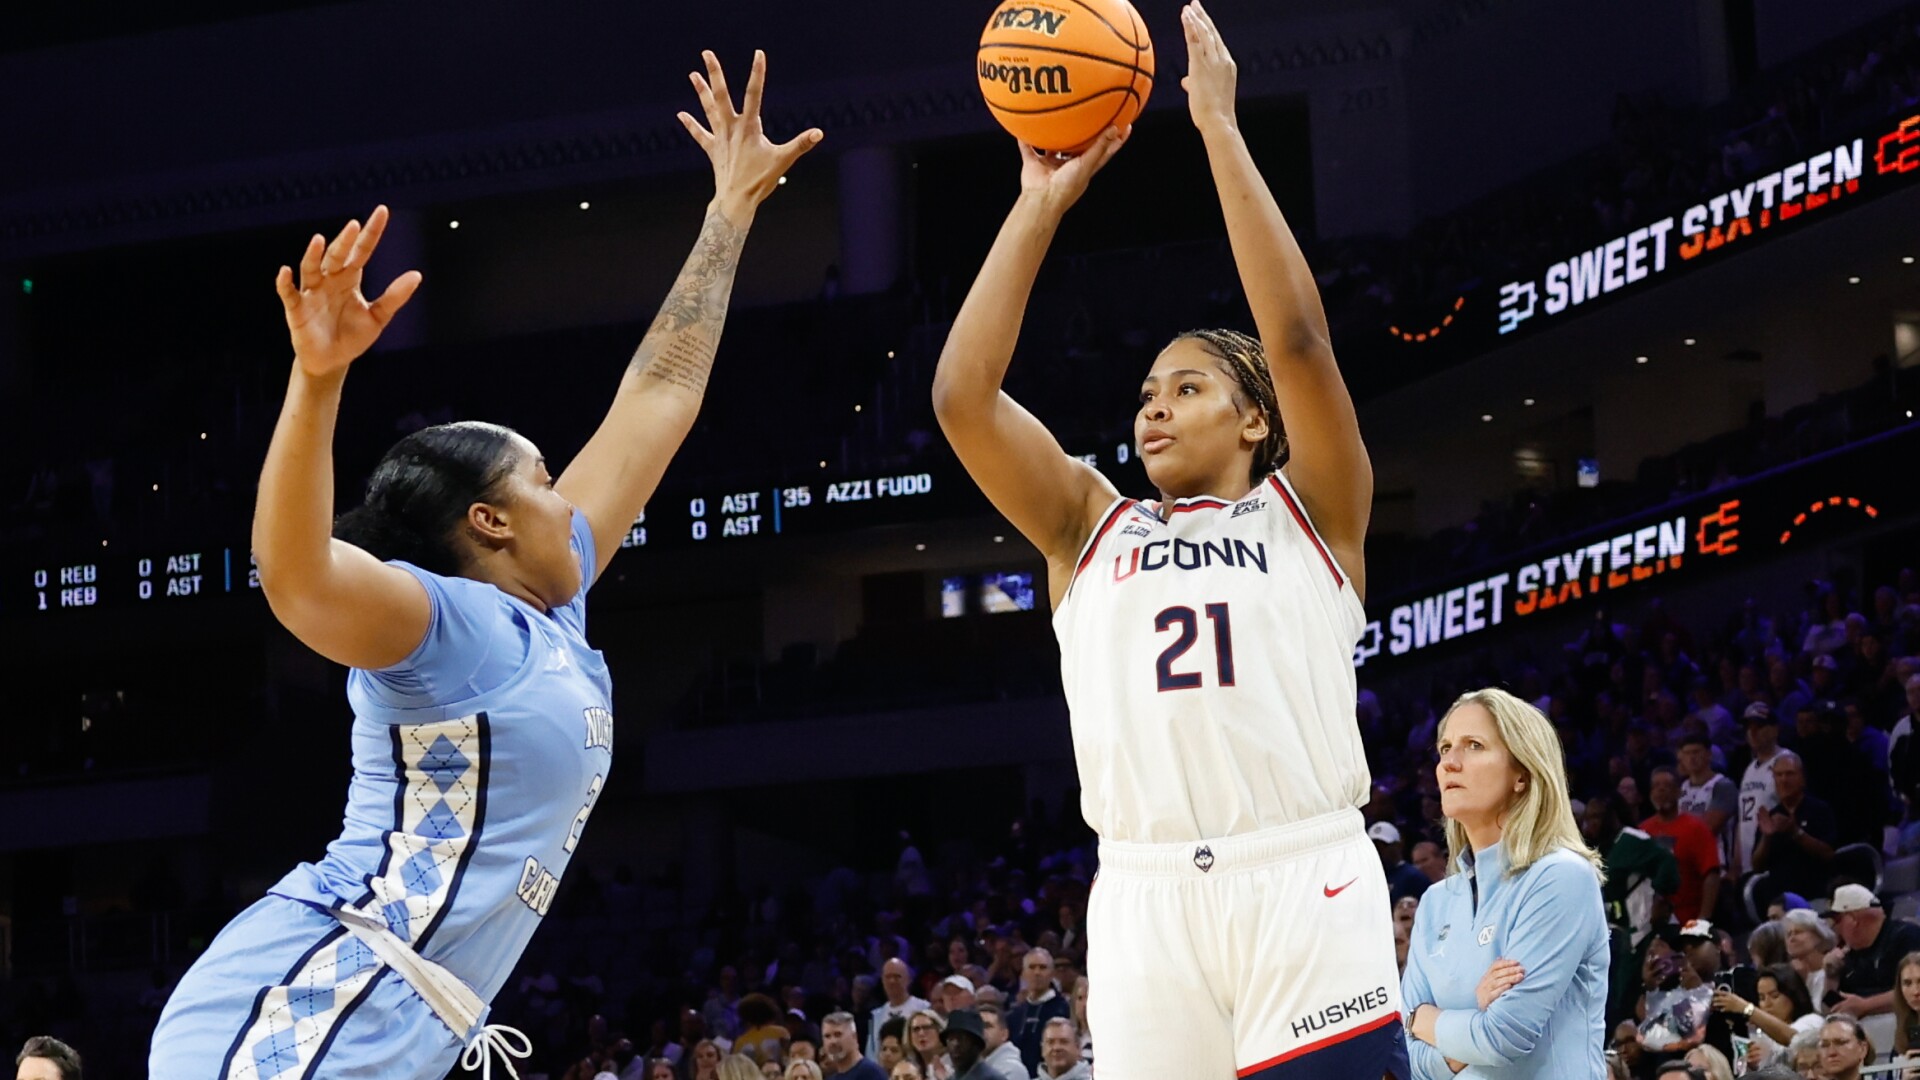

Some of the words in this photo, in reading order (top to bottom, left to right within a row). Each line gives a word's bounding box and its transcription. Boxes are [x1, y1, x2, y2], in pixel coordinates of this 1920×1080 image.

[979, 58, 1072, 94] Wilson
[1544, 217, 1673, 316] SWEET
[1679, 138, 1863, 261] SIXTEEN
[690, 497, 705, 517] 0
[721, 492, 760, 514] AST
[783, 486, 811, 507] 35
[826, 479, 872, 503] AZZI
[877, 473, 932, 498] FUDD
[1235, 498, 1260, 509] BIG
[1231, 502, 1268, 516] EAST
[622, 527, 647, 548] EB
[692, 520, 707, 540] 0
[722, 515, 762, 538] AST
[34, 569, 48, 588] 0
[60, 564, 97, 586] REB
[139, 558, 152, 578] 0
[166, 553, 202, 575] AST
[1112, 538, 1268, 584] UCONN
[37, 591, 48, 610] 1
[60, 586, 97, 608] REB
[139, 579, 152, 599] 0
[166, 575, 203, 597] AST
[1388, 572, 1510, 656] SWEET
[1514, 516, 1686, 616] SIXTEEN
[1154, 602, 1236, 693] 21
[1742, 796, 1756, 822] 12
[1290, 986, 1389, 1039] HUSKIES
